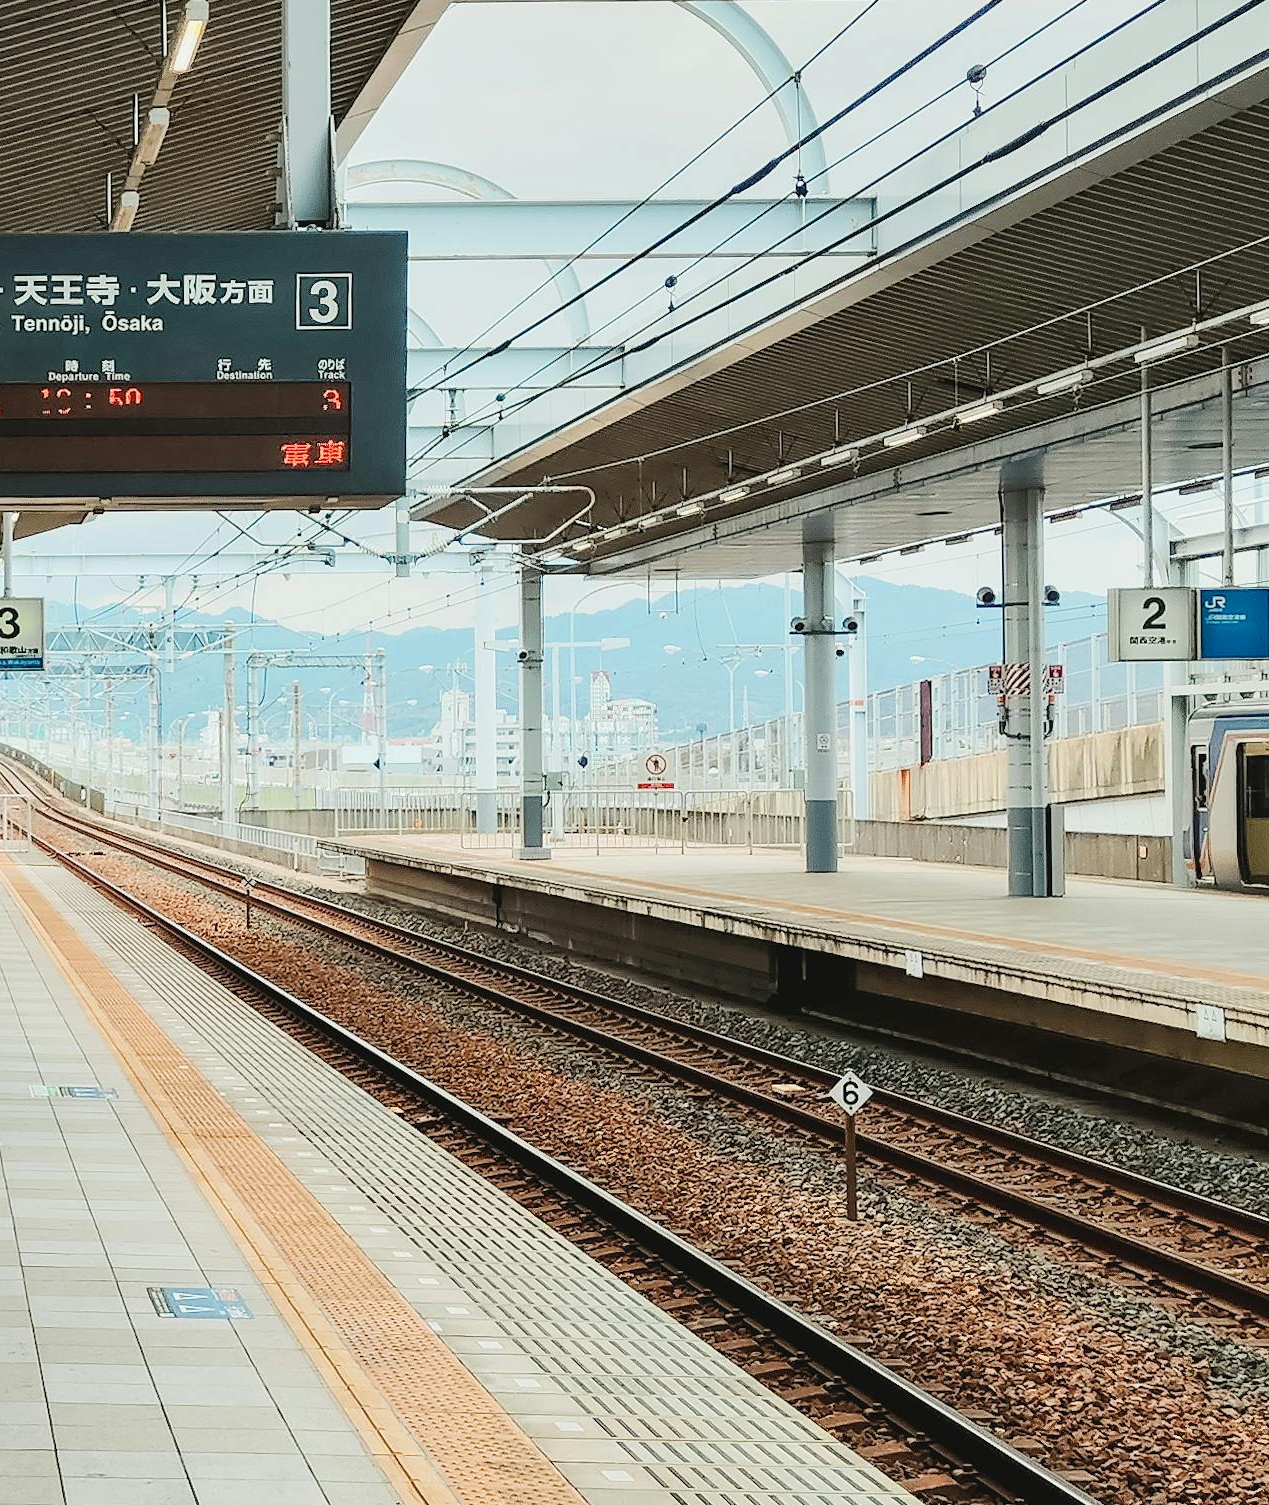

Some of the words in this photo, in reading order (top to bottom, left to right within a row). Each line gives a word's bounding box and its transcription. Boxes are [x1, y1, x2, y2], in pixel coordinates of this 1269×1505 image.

[309, 280, 339, 324] 3
[11, 314, 91, 335] Tennōji,
[102, 311, 164, 332] Ōsaka
[217, 358, 273, 371] 行先
[318, 358, 345, 371] のりば
[48, 371, 99, 383] Departure
[105, 371, 131, 382] Time
[216, 370, 273, 381] Destination
[318, 370, 346, 380] Track
[1204, 595, 1227, 609] JR
[1142, 596, 1167, 630] 2
[842, 1080, 859, 1105] 6
